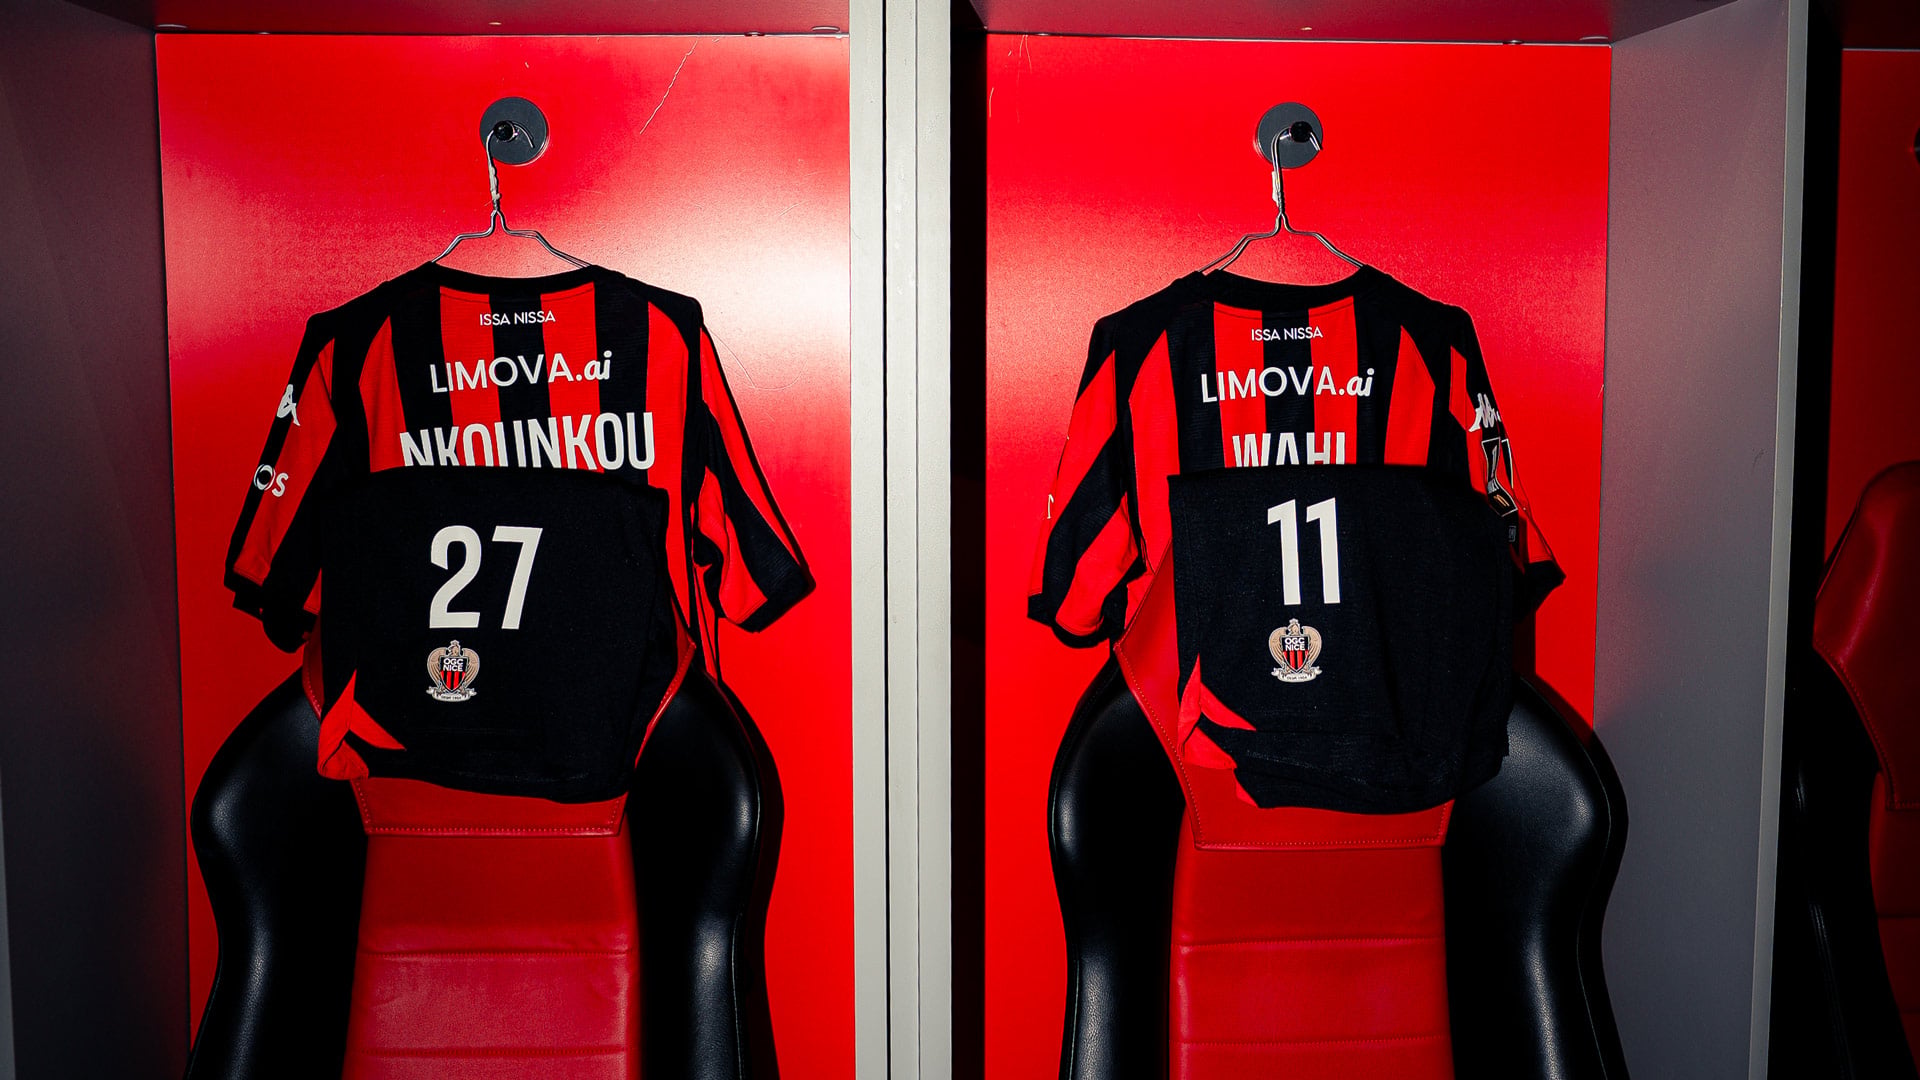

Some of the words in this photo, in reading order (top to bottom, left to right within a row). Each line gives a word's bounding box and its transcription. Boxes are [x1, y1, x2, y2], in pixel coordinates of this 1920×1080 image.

[479, 313, 511, 326] ISSA
[514, 311, 556, 325] NISSA
[1251, 328, 1281, 341] ISSA
[1284, 326, 1324, 340] NISSA
[430, 350, 613, 393] LIMOVA.ai
[1201, 366, 1375, 403] LIMOVA.ai
[400, 412, 656, 471] NKOUNKOU
[1268, 498, 1341, 606] 11
[429, 525, 544, 630] 27
[1284, 637, 1305, 645] OGC
[443, 664, 464, 672] NICE
